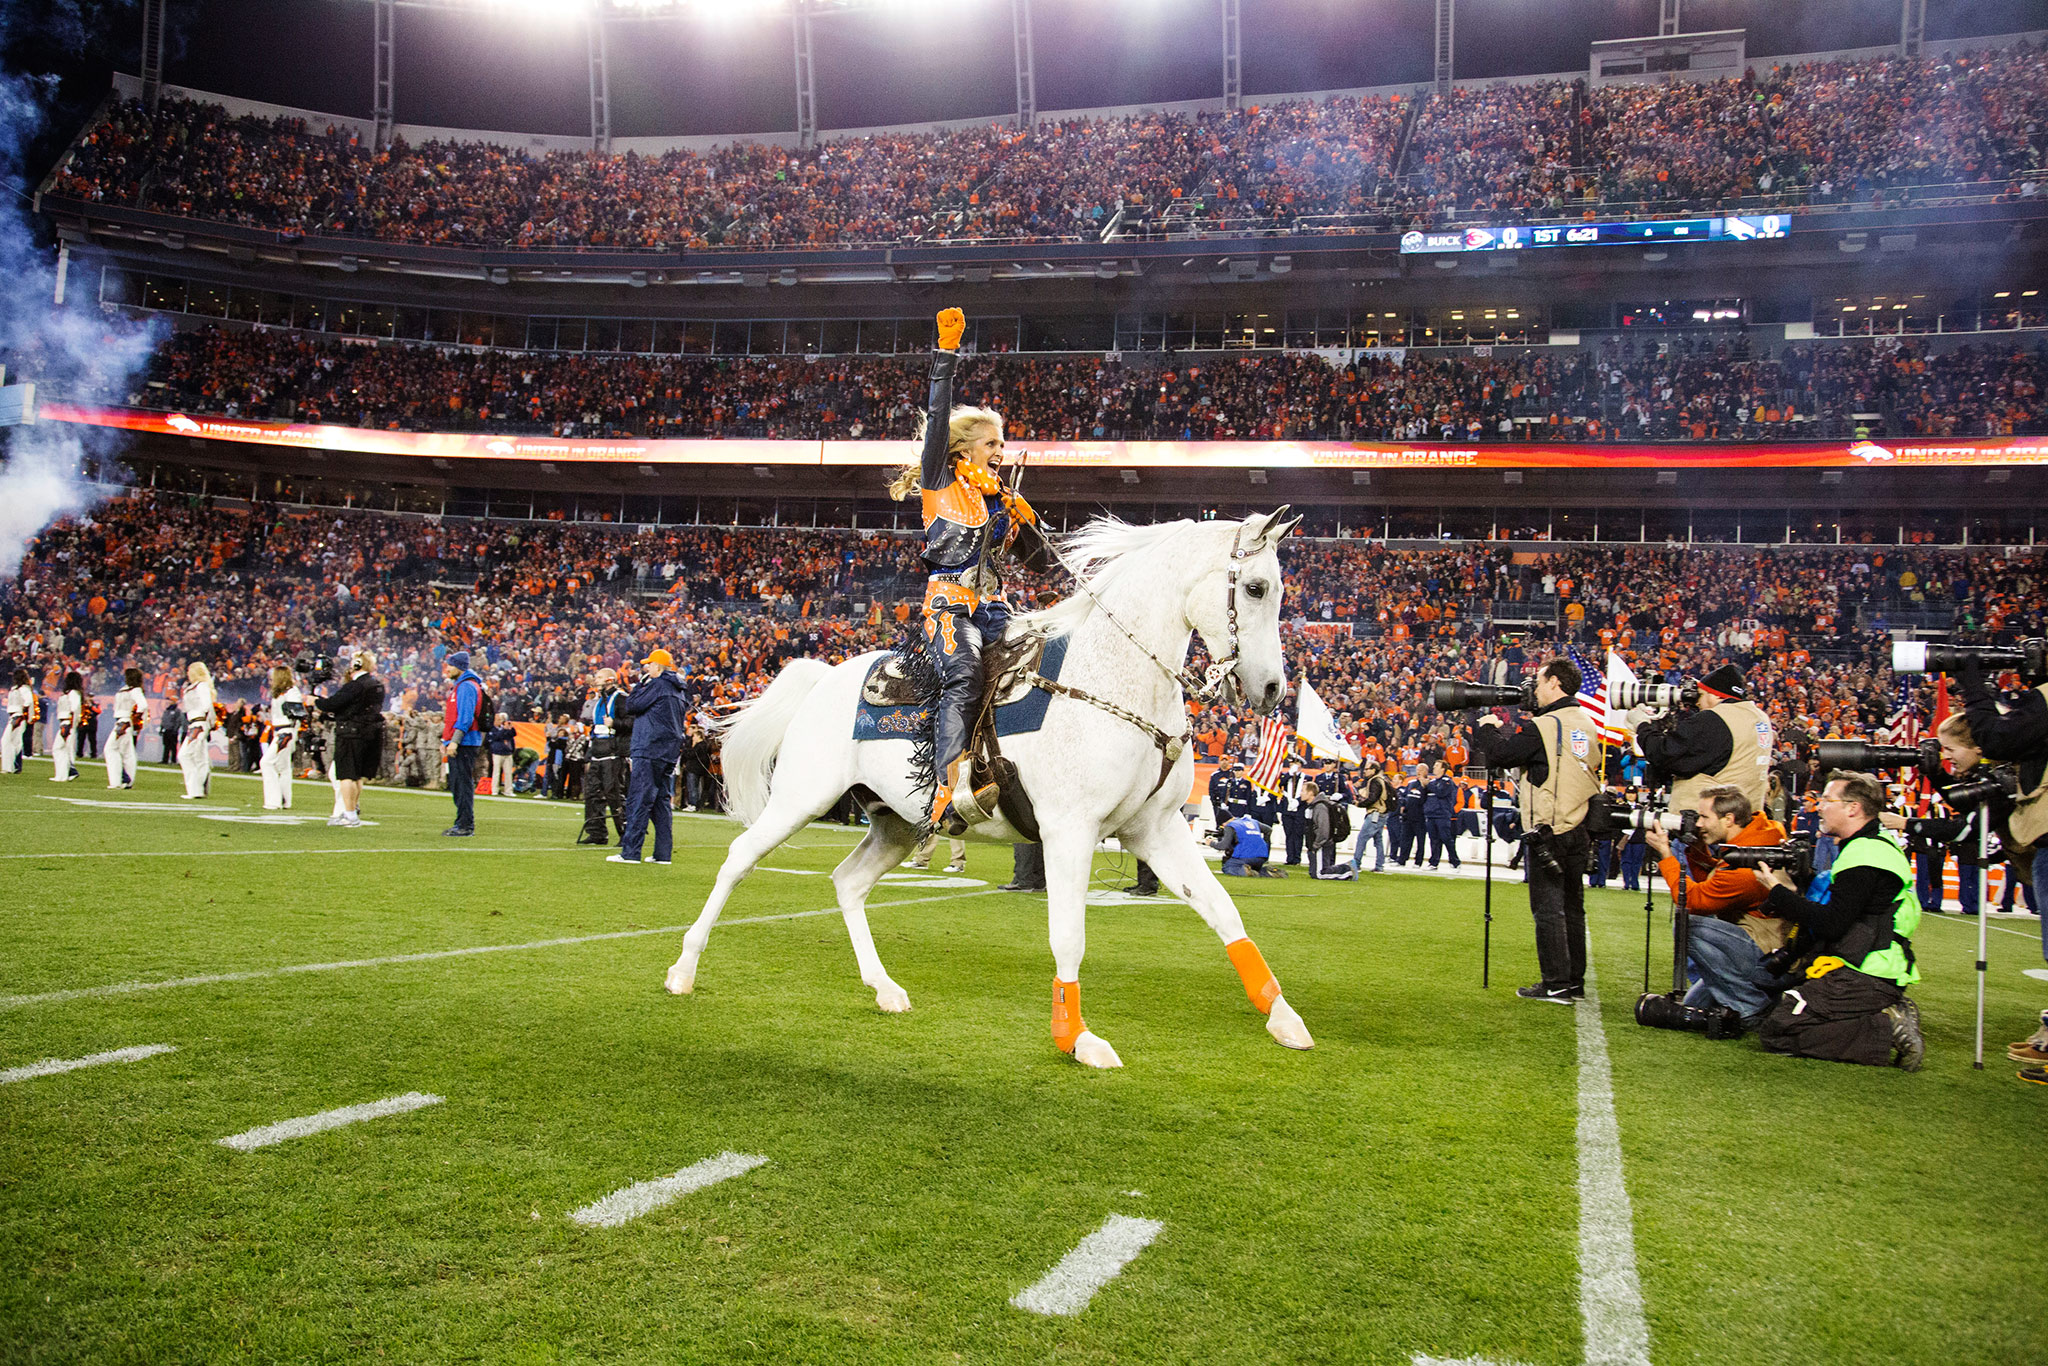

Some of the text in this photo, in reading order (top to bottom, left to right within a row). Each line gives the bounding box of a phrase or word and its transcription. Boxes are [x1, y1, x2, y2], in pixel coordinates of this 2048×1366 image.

[1762, 215, 1779, 233] 0
[1427, 236, 1461, 247] BUICK
[1502, 228, 1518, 245] 0
[1533, 228, 1598, 242] 1ST 6:21
[203, 423, 261, 440] UNITED
[265, 431, 279, 441] IN
[516, 445, 646, 459] UNITED IN ORANGE
[1044, 451, 1112, 464] ORANGE
[1314, 451, 1478, 465] UNITED IN ORANGE
[1896, 448, 1976, 463] UNITED
[1981, 449, 2001, 462] IN
